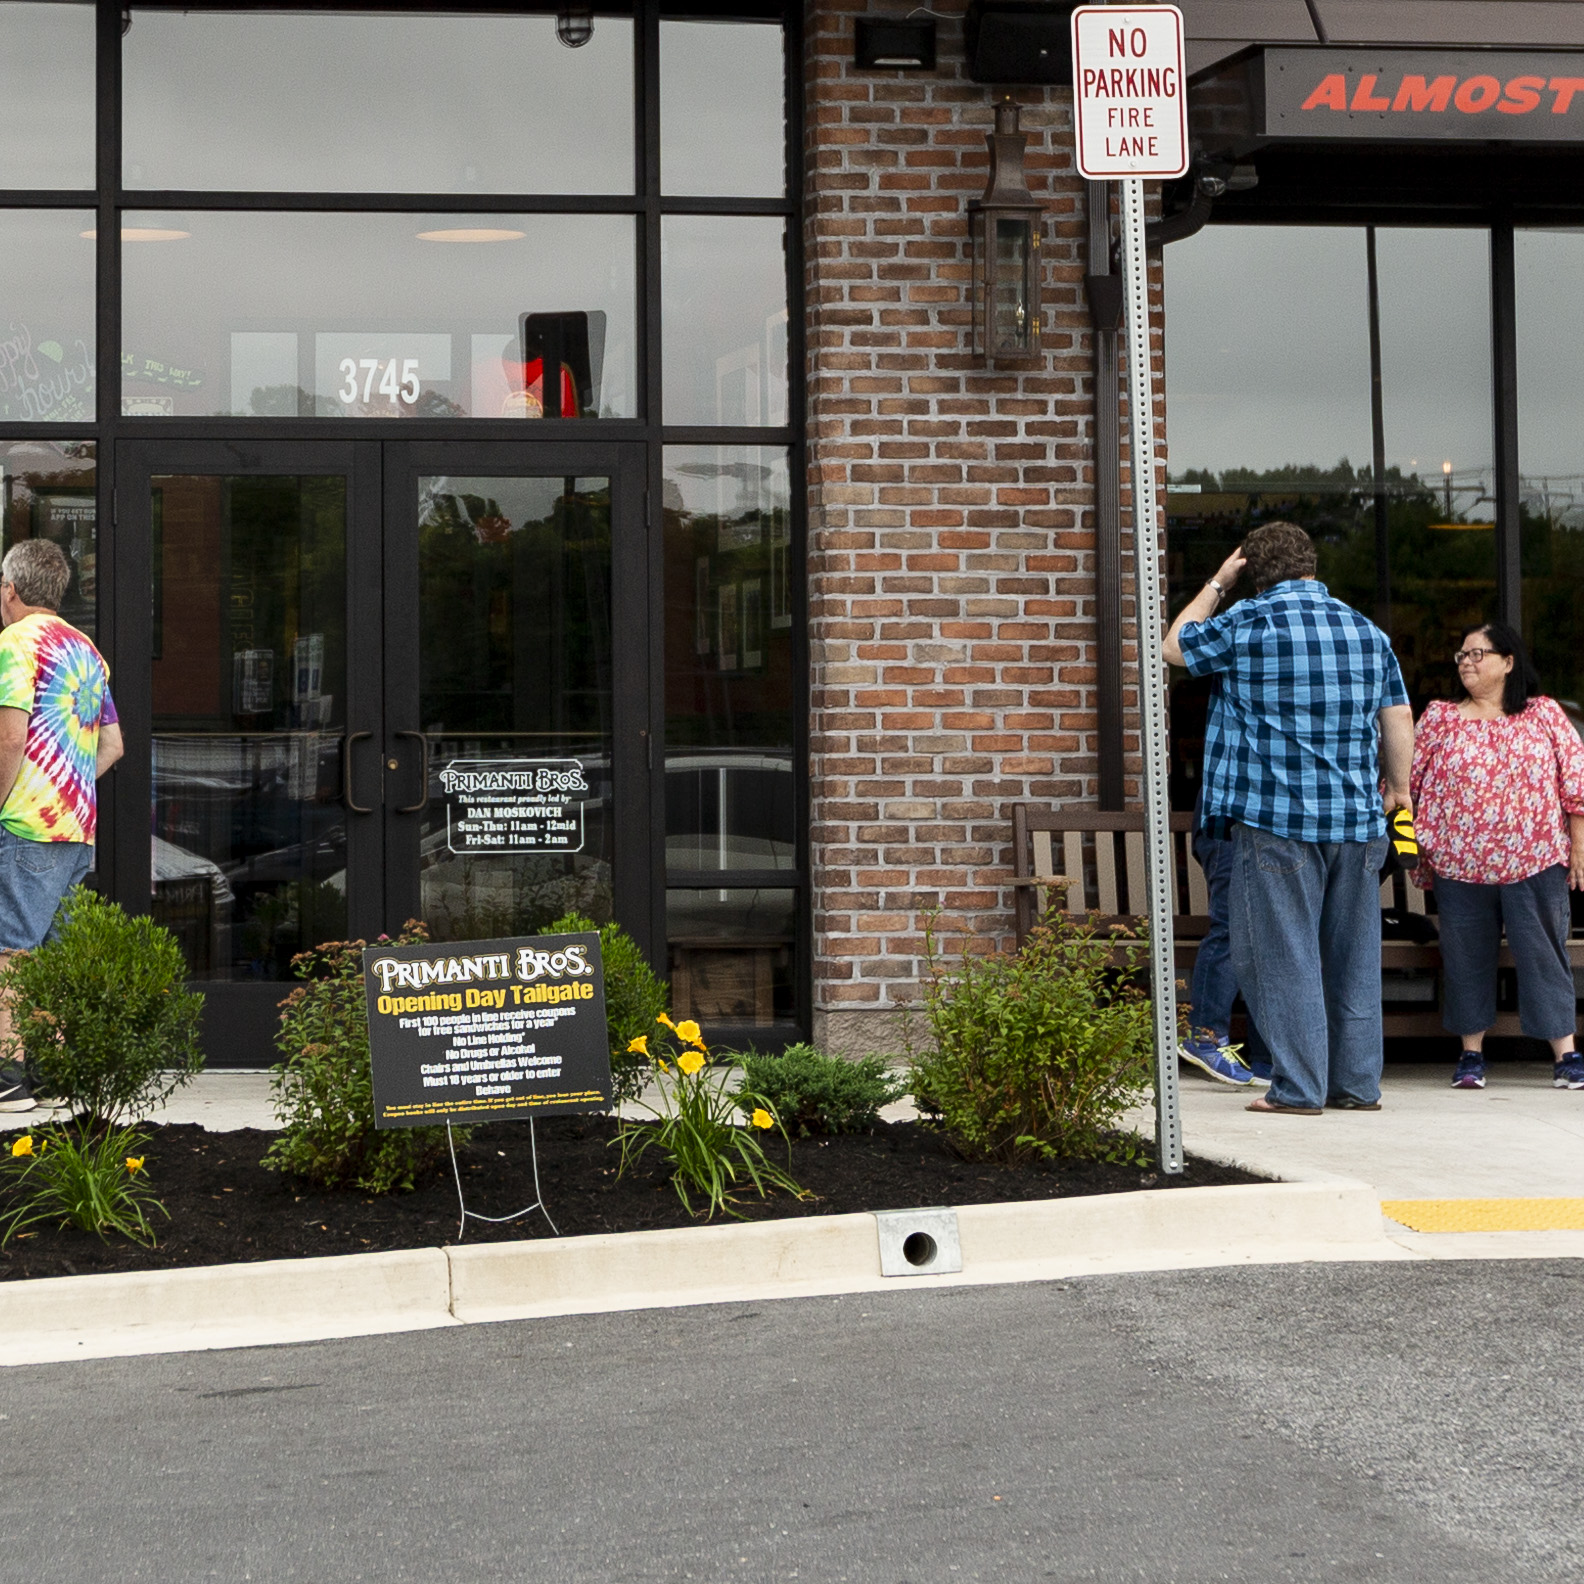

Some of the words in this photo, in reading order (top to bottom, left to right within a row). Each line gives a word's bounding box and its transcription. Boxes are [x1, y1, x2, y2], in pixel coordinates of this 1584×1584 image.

[1108, 28, 1147, 57] NO
[1084, 67, 1176, 98] PARKING
[1108, 107, 1154, 127] FIRE
[1106, 137, 1158, 157] LANE
[338, 357, 420, 404] 3745
[439, 769, 533, 793] PRIMANTI
[536, 768, 588, 792] BROS.
[467, 807, 491, 818] DAN
[493, 806, 562, 818] MOSKOVICH
[458, 820, 507, 832] Sun-Thu:
[510, 820, 538, 831] 11am
[546, 820, 576, 830] 12mid
[465, 834, 505, 845] Fri-Sat:
[509, 833, 536, 844] 11am
[545, 833, 568, 844] 2am
[373, 954, 510, 993] PRIMANTI
[516, 945, 593, 982] BROS.
[377, 992, 462, 1015] Opening
[465, 986, 506, 1009] Day
[510, 980, 594, 1005] Tailgate
[452, 1036, 466, 1046] No
[445, 1049, 459, 1060] No
[460, 1048, 488, 1059] Drugs
[501, 1043, 535, 1056] Alcohol
[420, 1063, 451, 1074] Chairs
[452, 1061, 469, 1072] and
[470, 1058, 517, 1071] Umbrellas
[518, 1056, 562, 1067] Welcome
[422, 1075, 448, 1087] Must
